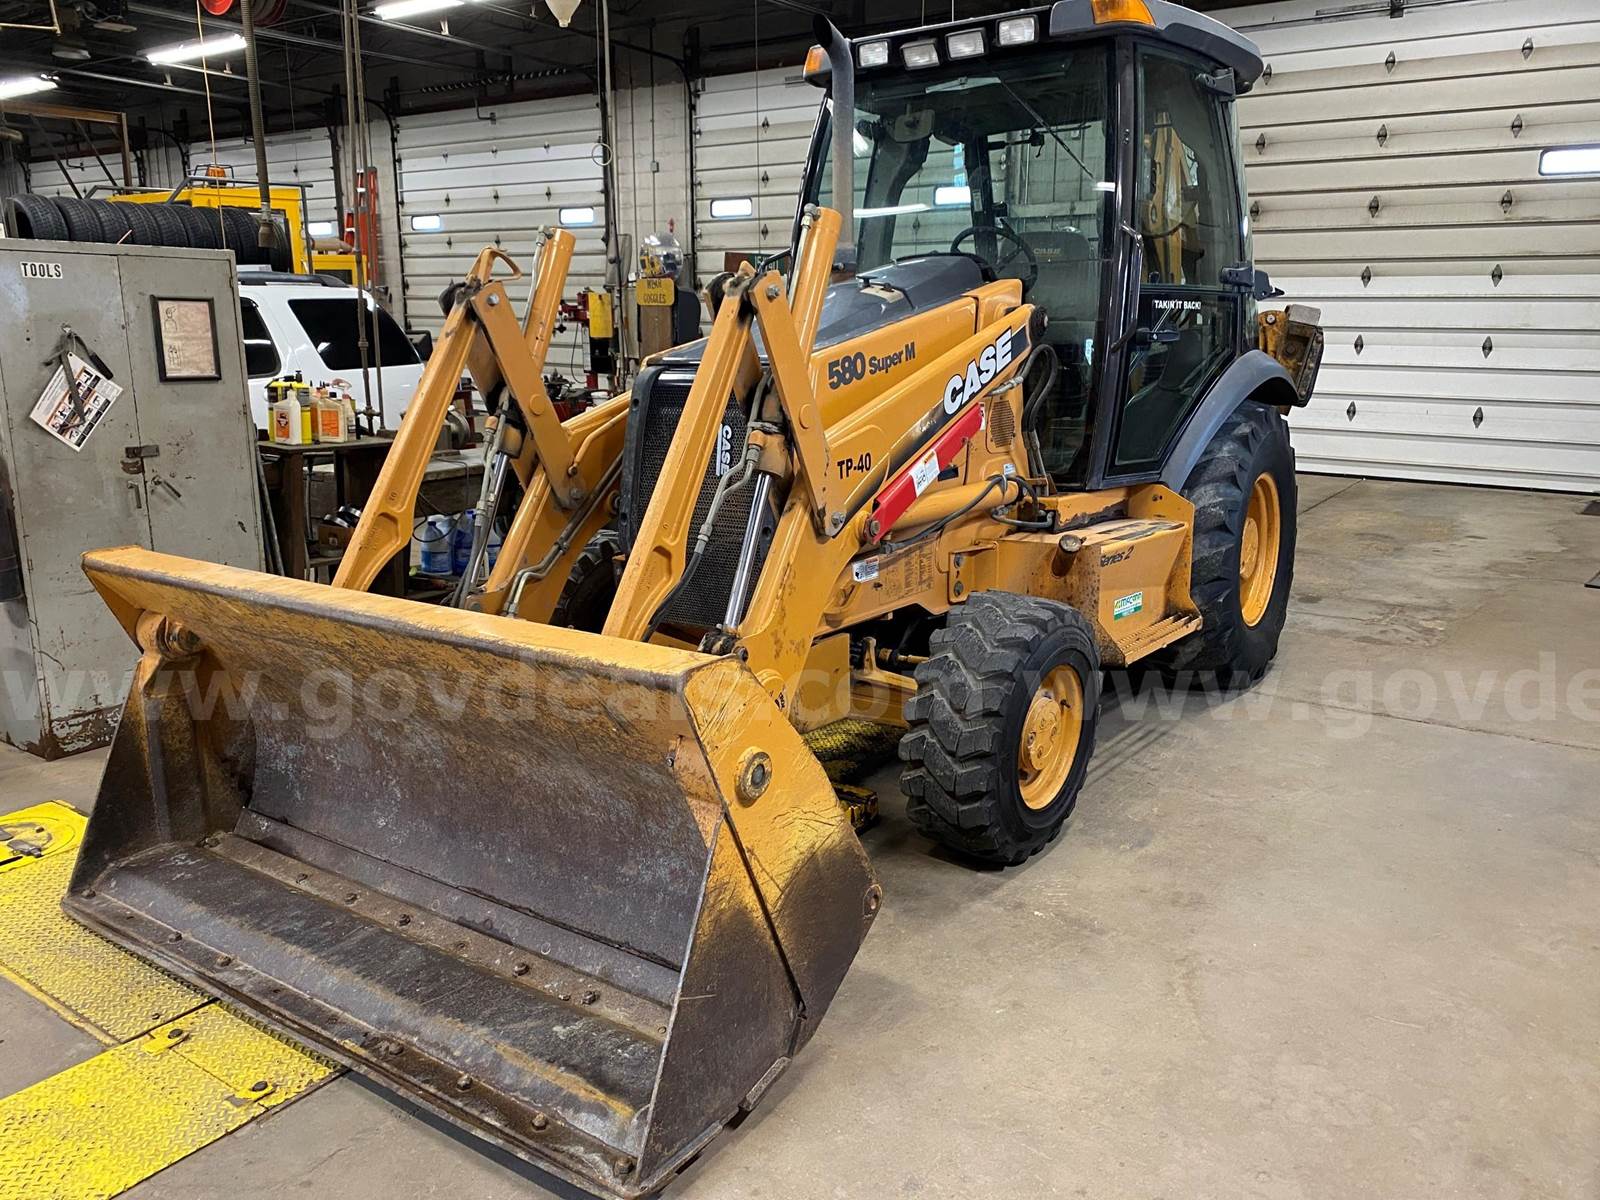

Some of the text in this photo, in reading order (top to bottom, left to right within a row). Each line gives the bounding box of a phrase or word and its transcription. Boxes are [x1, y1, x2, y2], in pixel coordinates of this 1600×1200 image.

[21, 262, 61, 278] TOOLS
[828, 341, 916, 390] 580 Super M
[943, 326, 1012, 415] CASE
[721, 424, 732, 476] CASE
[837, 452, 871, 480] TP-40
[1100, 544, 1134, 567] Series 2
